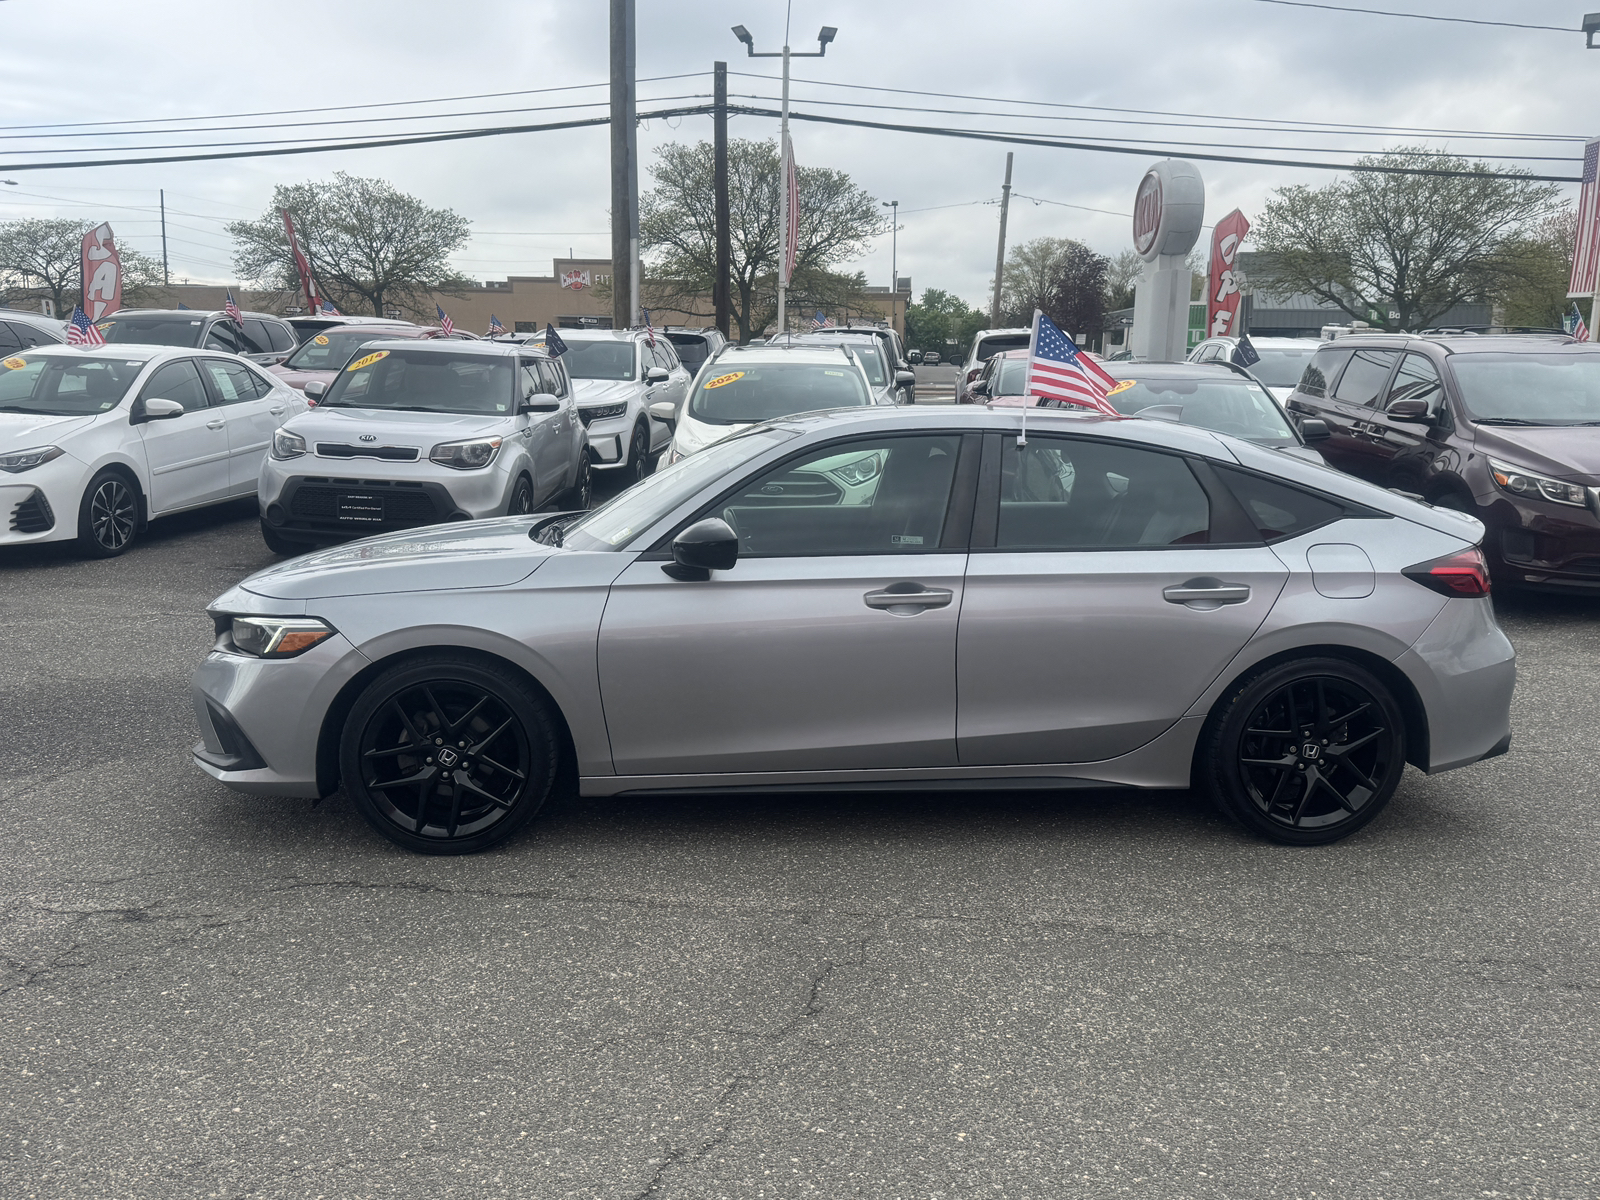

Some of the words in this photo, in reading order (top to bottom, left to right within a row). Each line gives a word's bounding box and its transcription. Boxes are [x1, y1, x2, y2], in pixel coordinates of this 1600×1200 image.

[1138, 188, 1159, 238] KIA
[561, 269, 592, 288] CRUNCH
[595, 274, 611, 285] FIT
[1210, 233, 1240, 338] OPE
[708, 372, 740, 388] 2021
